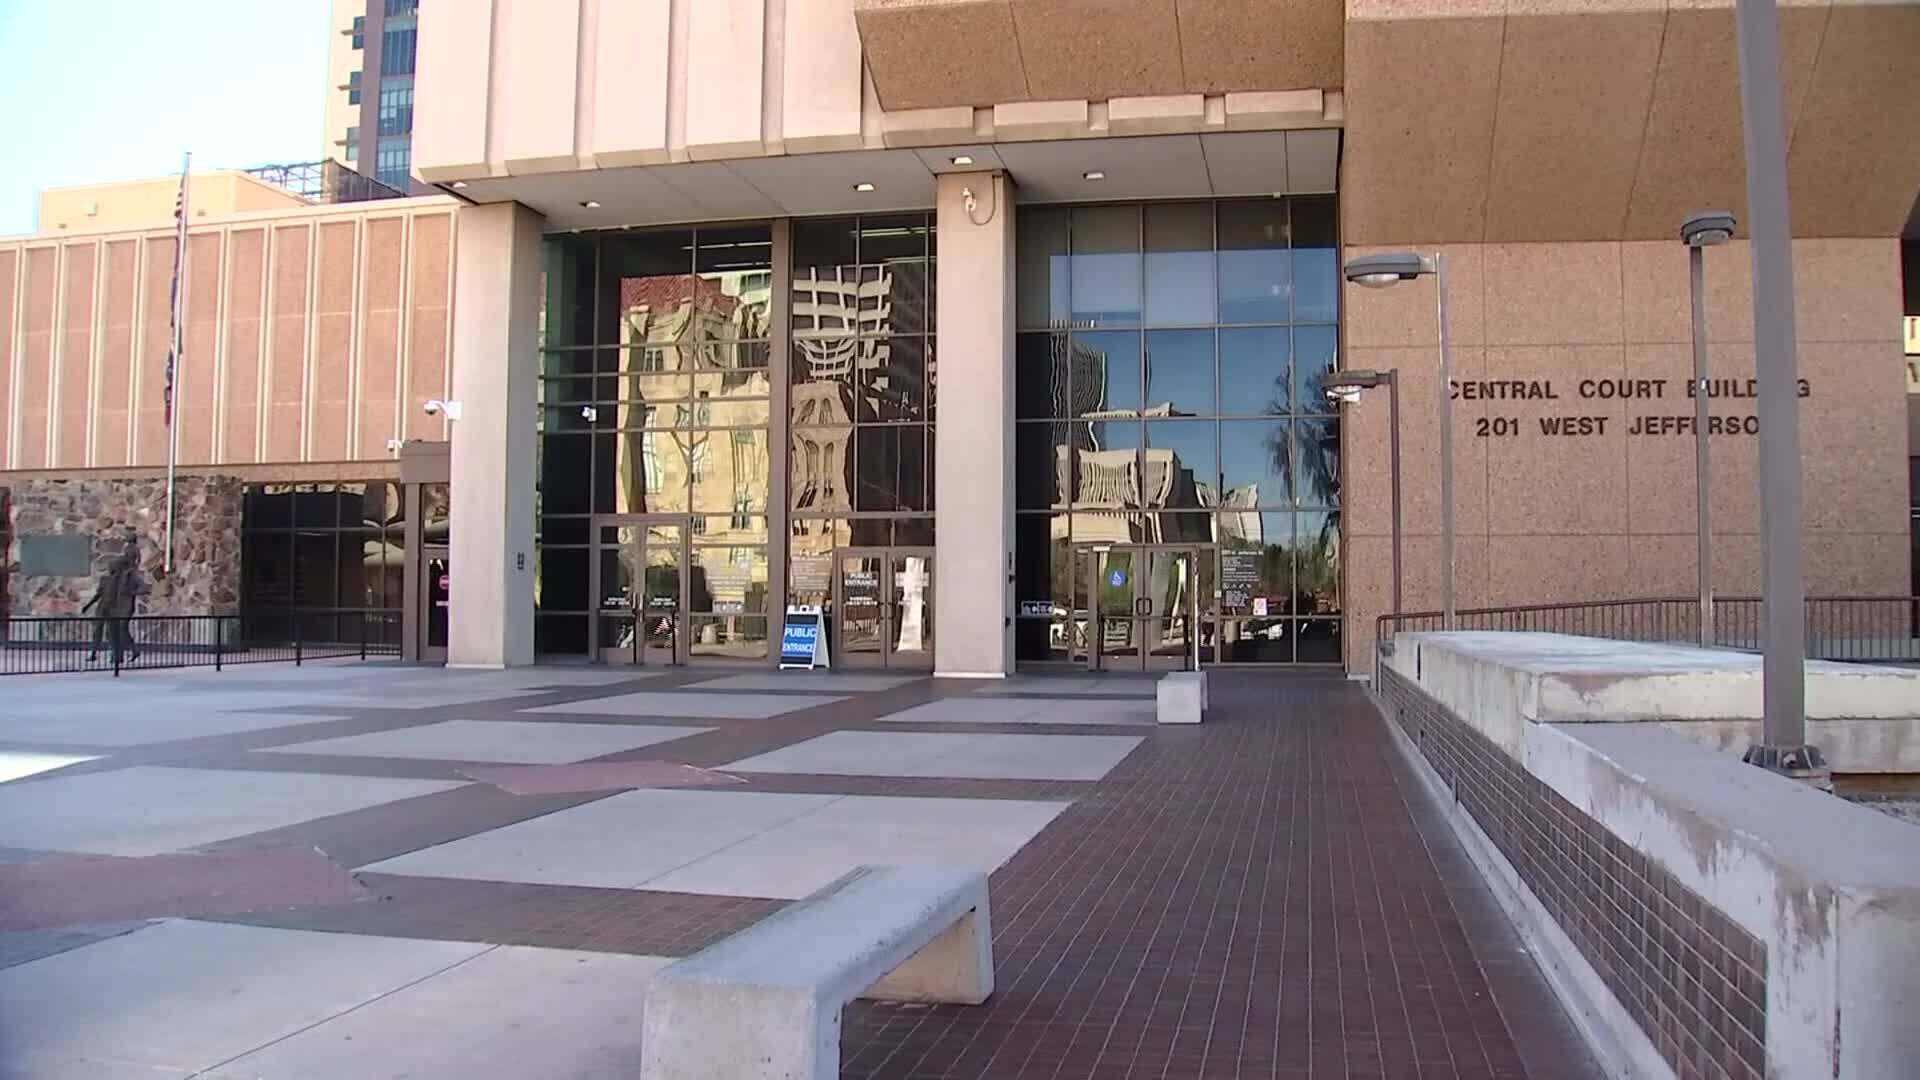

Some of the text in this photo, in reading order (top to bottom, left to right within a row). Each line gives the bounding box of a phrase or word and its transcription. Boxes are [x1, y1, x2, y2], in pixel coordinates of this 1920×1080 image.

[1579, 379, 1666, 398] COURT
[1687, 379, 1811, 398] BUILDG
[1476, 416, 1760, 437] 201 WEST JEFFRSO
[784, 627, 817, 638] PUBLIC
[782, 642, 813, 652] ENTRANCE
